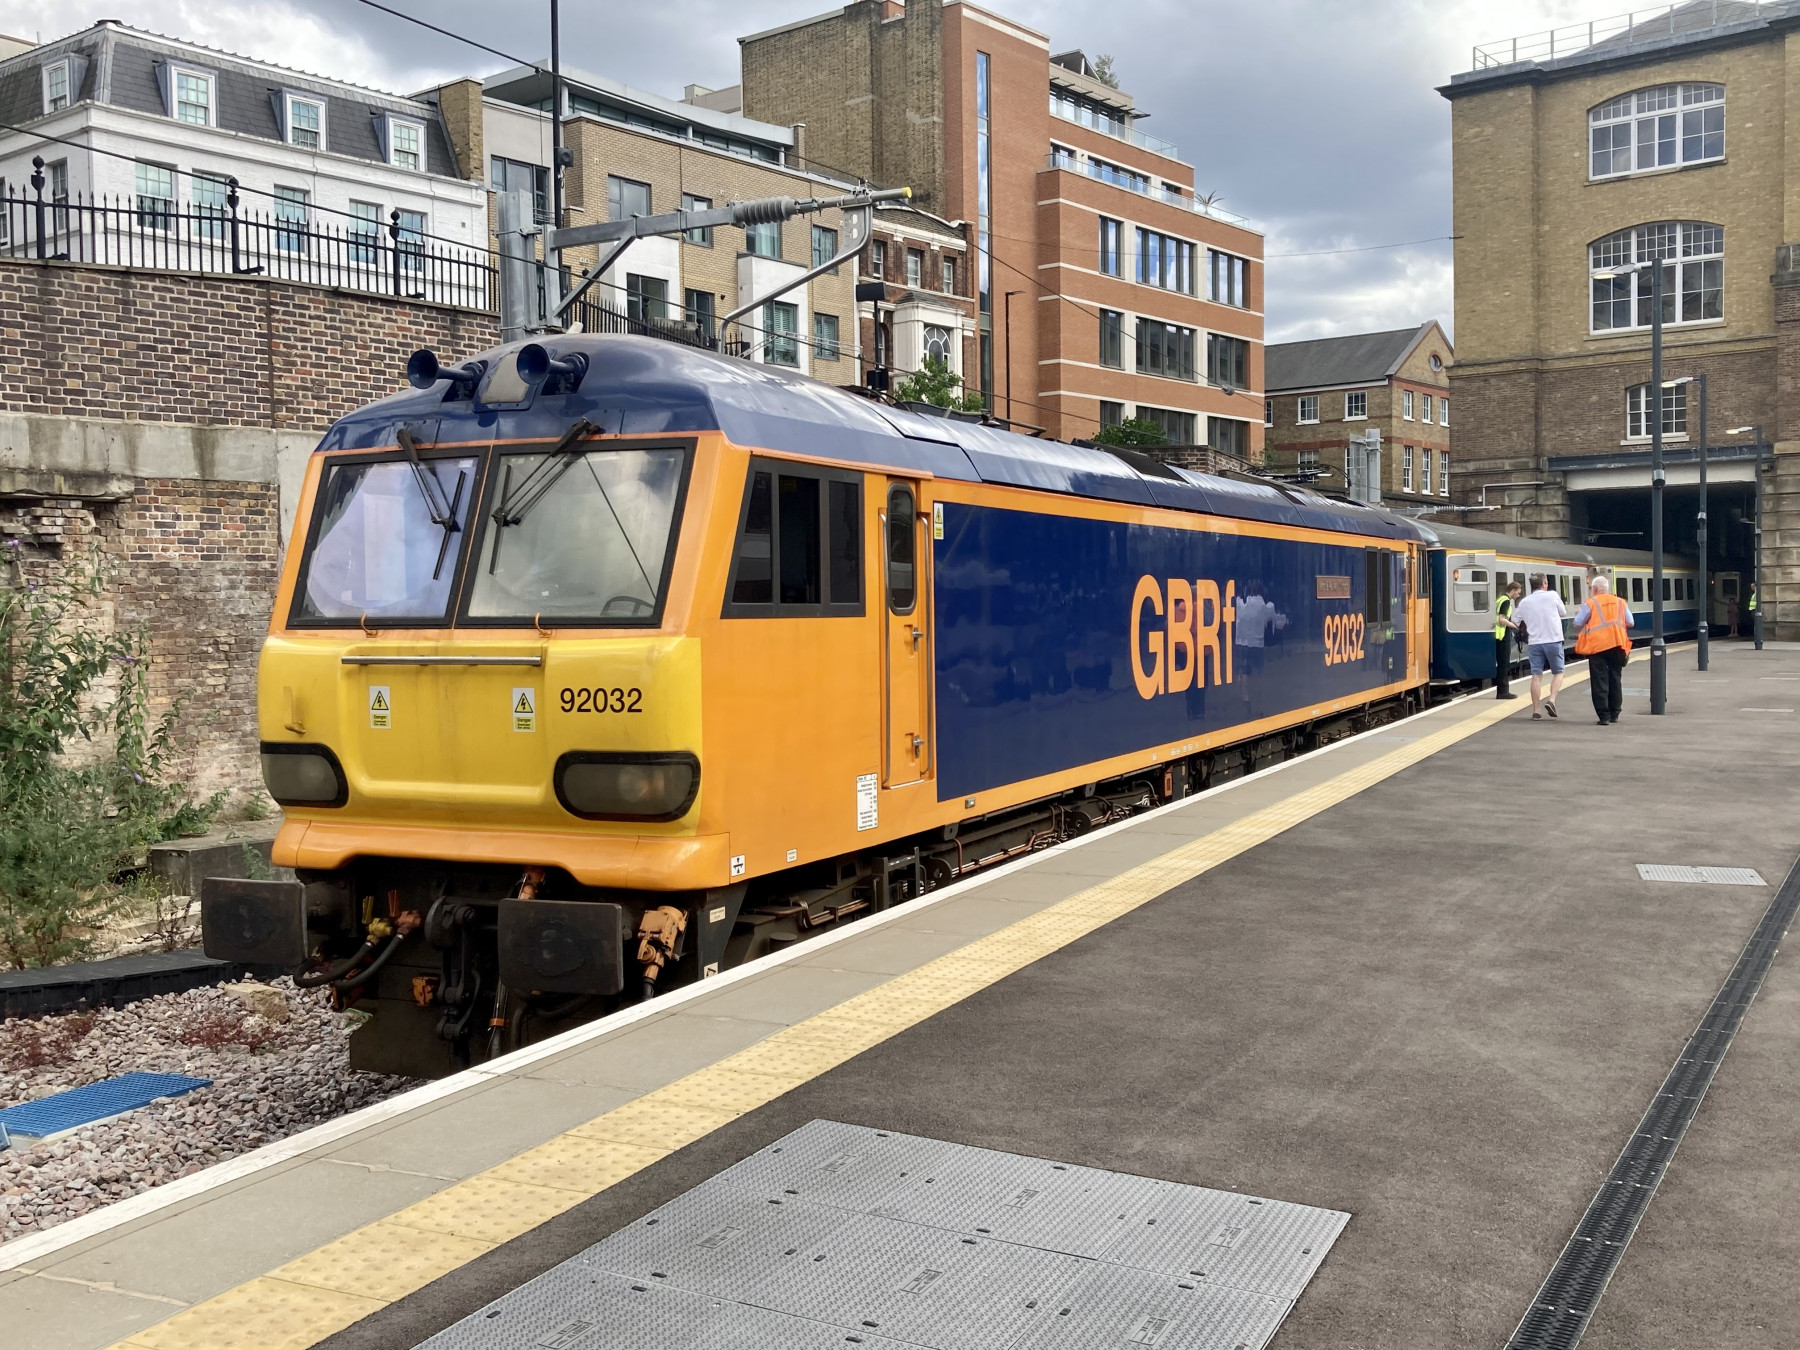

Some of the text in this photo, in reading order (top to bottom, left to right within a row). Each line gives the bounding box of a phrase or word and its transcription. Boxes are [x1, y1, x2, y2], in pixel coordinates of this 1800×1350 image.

[1130, 574, 1236, 700] GBRf
[1324, 612, 1365, 667] 92032
[560, 688, 643, 713] 92032
